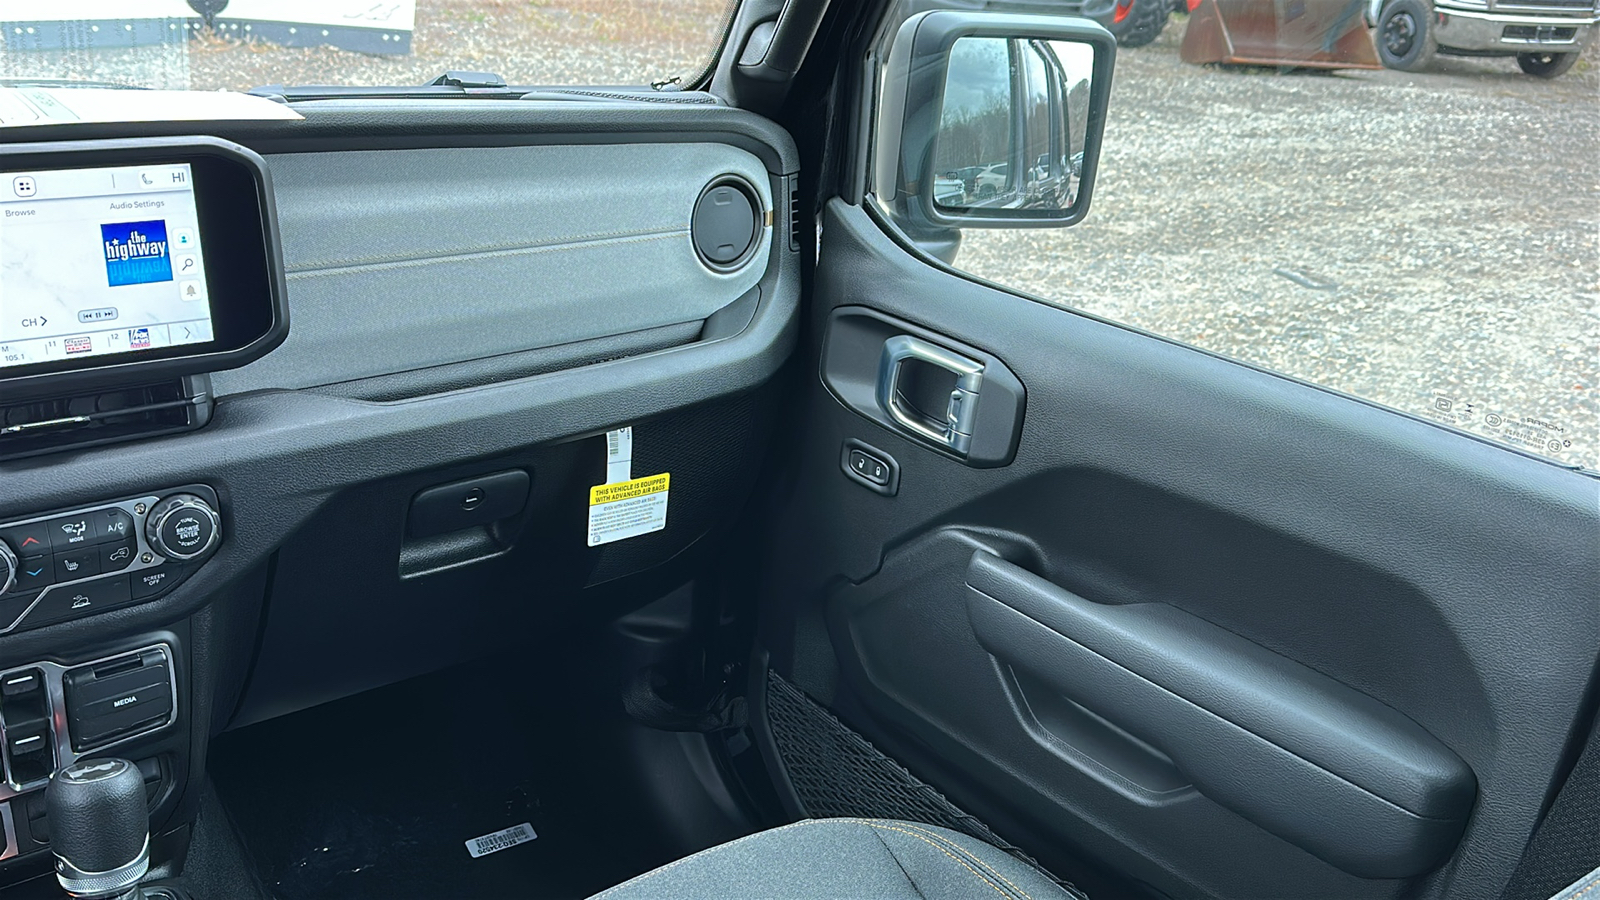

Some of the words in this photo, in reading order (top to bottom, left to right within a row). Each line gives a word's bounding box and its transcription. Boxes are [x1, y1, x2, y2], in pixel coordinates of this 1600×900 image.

[171, 172, 186, 183] HI
[109, 202, 133, 210] Audio
[134, 199, 165, 210] Settings
[5, 208, 36, 218] Browse
[130, 230, 147, 244] the
[105, 239, 167, 262] highway
[21, 318, 38, 327] CH
[110, 333, 119, 341] 12
[596, 488, 609, 496] THIS
[611, 484, 633, 493] VEHICLE
[641, 478, 666, 487] EQUIPPED
[595, 495, 610, 503] WITH
[612, 490, 641, 500] ADVANCED
[652, 484, 665, 492] BAGS
[107, 522, 123, 532] A/C
[69, 535, 84, 543] MODE
[143, 573, 165, 583] SCREEN
[113, 695, 137, 708] MEDIA
